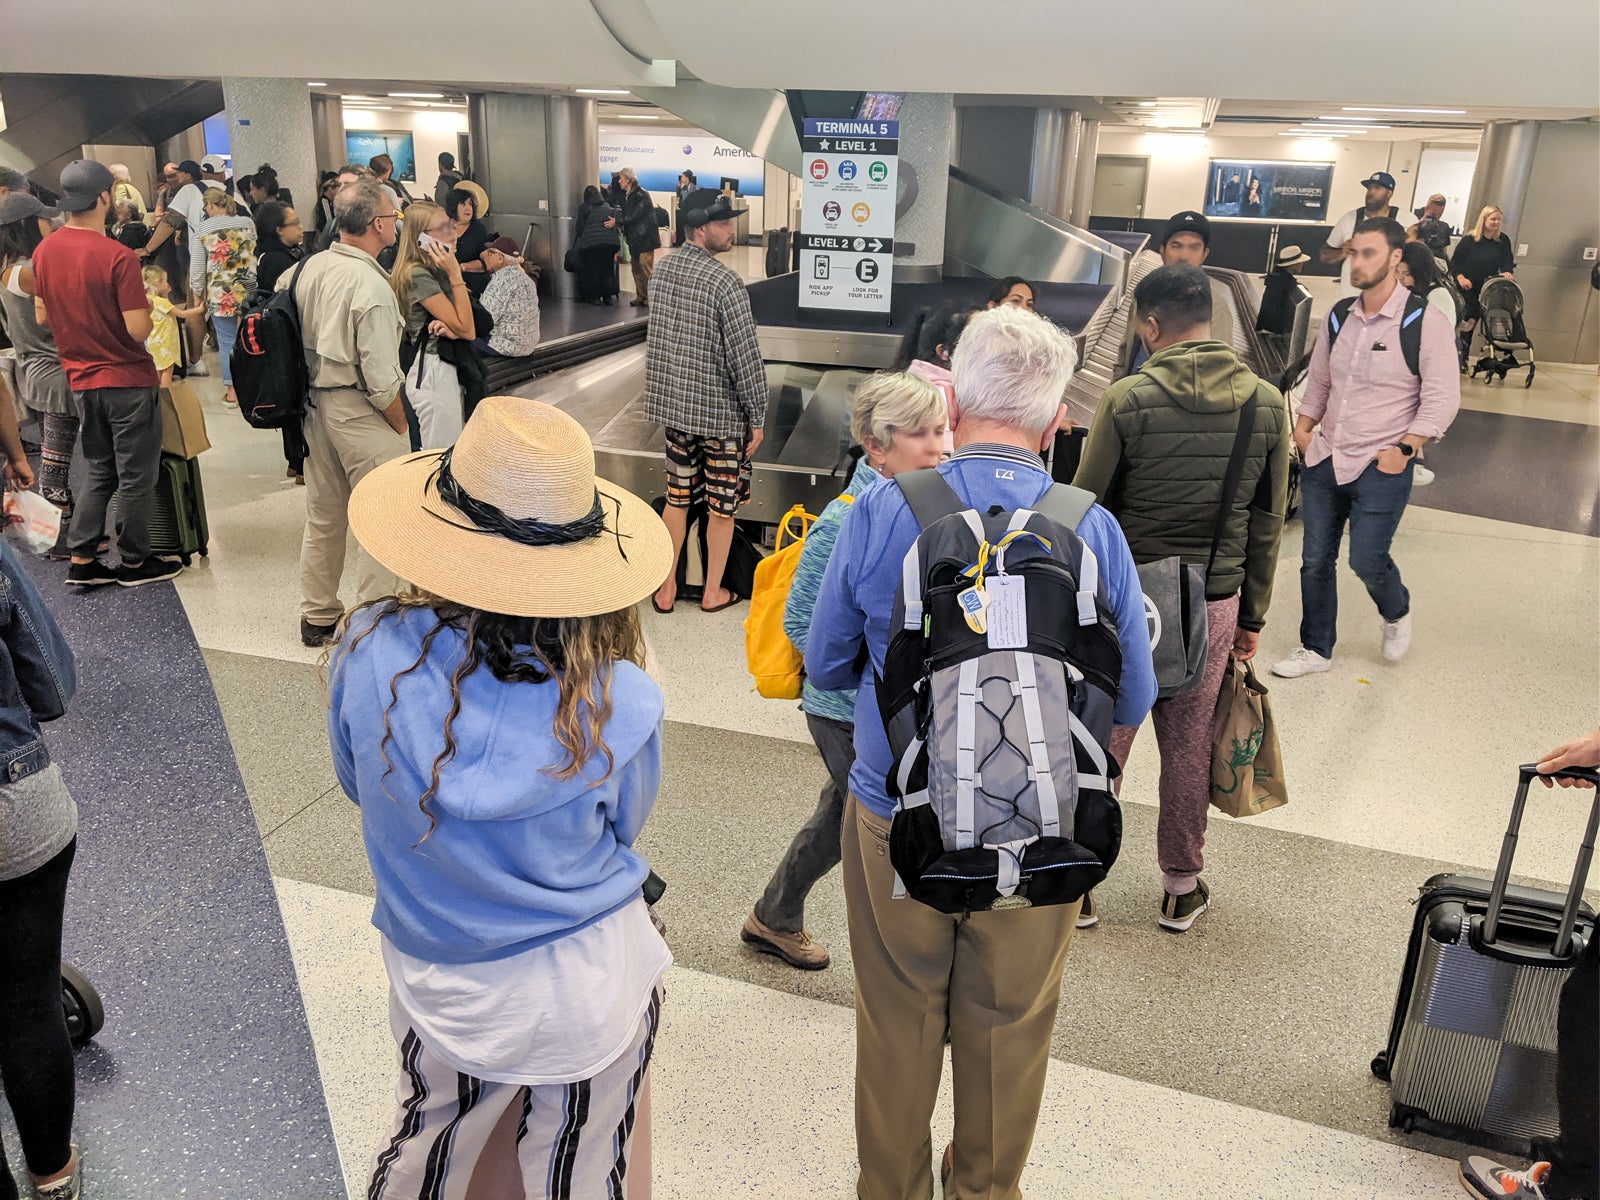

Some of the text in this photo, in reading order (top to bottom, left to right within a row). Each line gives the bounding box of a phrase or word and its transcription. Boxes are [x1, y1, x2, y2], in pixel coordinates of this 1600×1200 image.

[816, 122, 888, 134] TERMINAL 5
[713, 146, 756, 157] Americ
[835, 141, 877, 151] LEVEL 1
[808, 237, 849, 248] LEVEL 2
[861, 261, 874, 280] E
